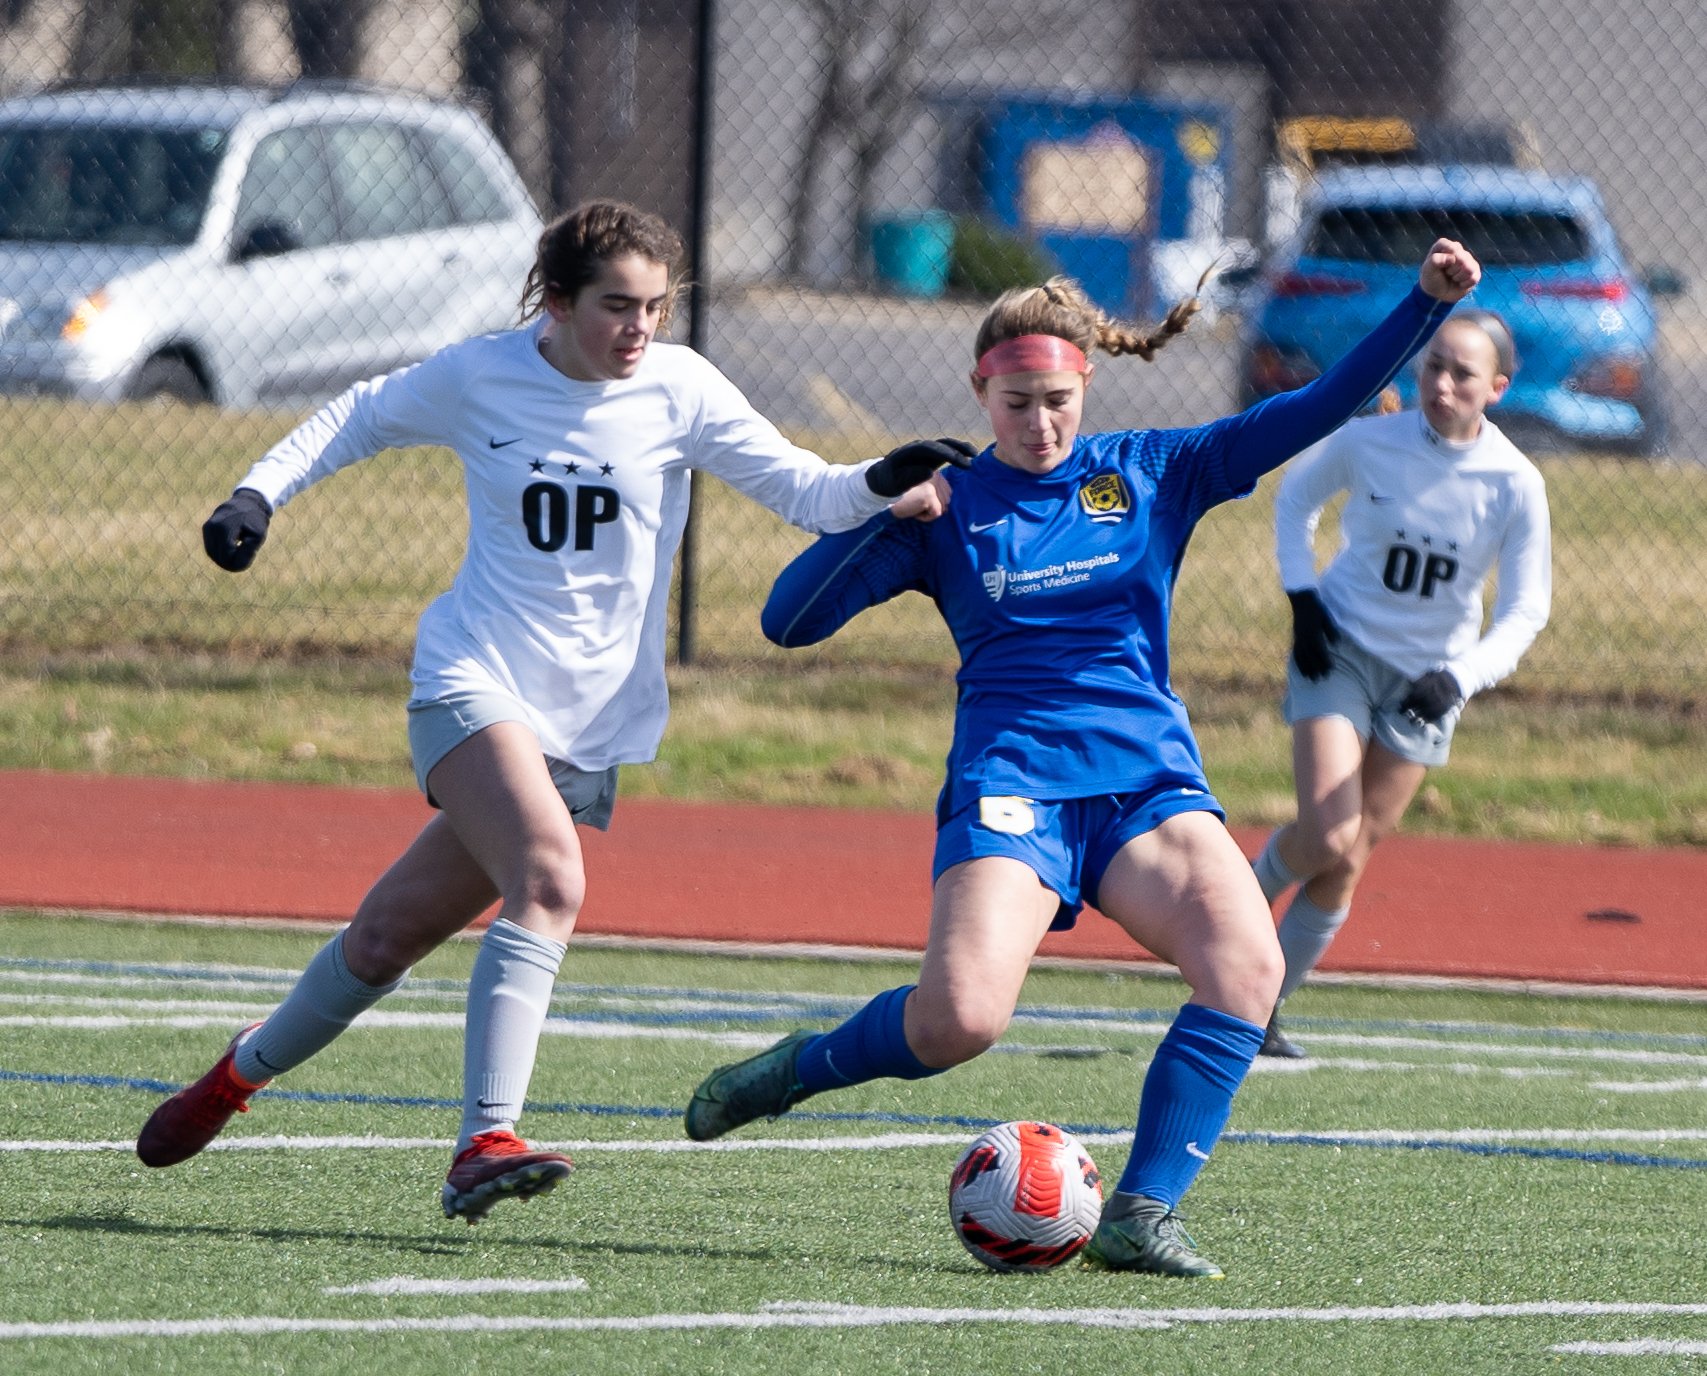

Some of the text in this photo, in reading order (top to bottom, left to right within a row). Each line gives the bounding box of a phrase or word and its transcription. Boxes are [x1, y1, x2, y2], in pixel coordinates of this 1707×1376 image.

[522, 481, 620, 552] OP
[1008, 552, 1120, 582] University Hospitals
[1009, 572, 1090, 597] Sports Medicine
[1382, 543, 1459, 598] OP
[979, 795, 1035, 836] 6
